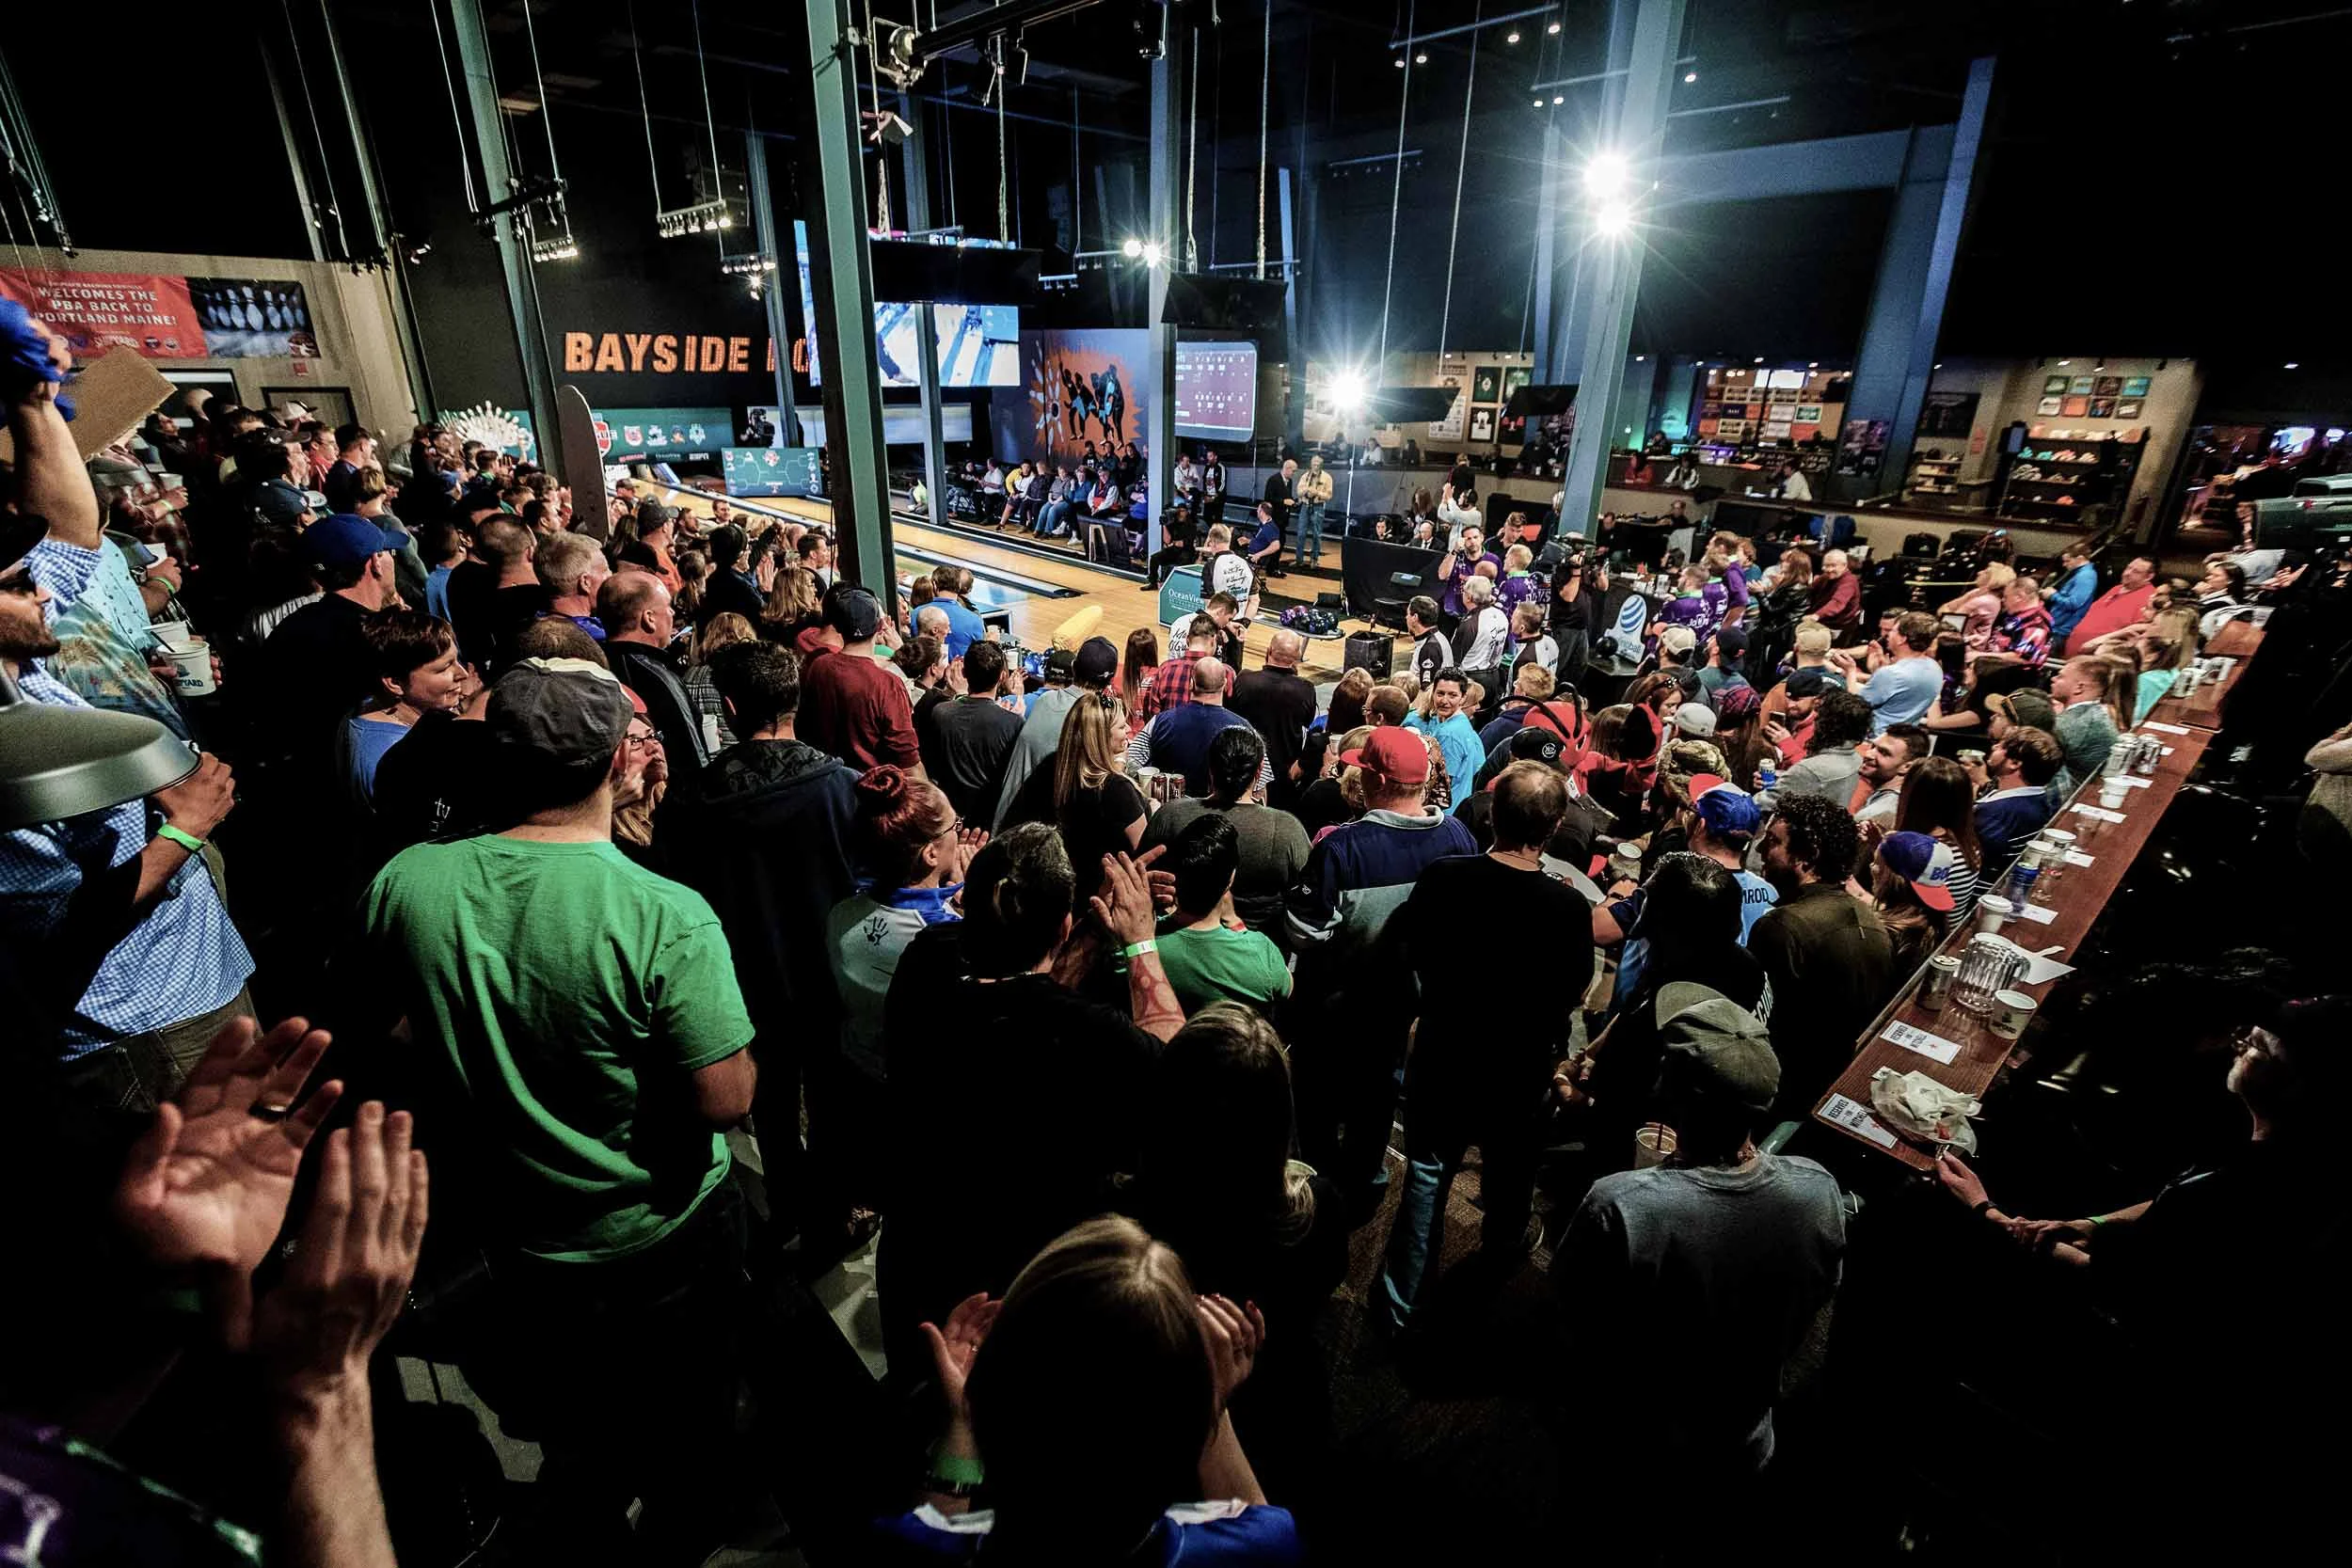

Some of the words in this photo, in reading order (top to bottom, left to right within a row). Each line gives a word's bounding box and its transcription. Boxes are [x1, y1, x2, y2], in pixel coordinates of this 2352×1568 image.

[38, 287, 128, 301] WELCOMES
[129, 290, 159, 302] THE
[51, 299, 84, 311] PBA
[89, 301, 130, 312] BACK
[134, 302, 154, 313] TO
[123, 314, 178, 325] MAINE!
[564, 331, 751, 373] BAYSIDE
[1827, 1099, 1850, 1119] RESERVED
